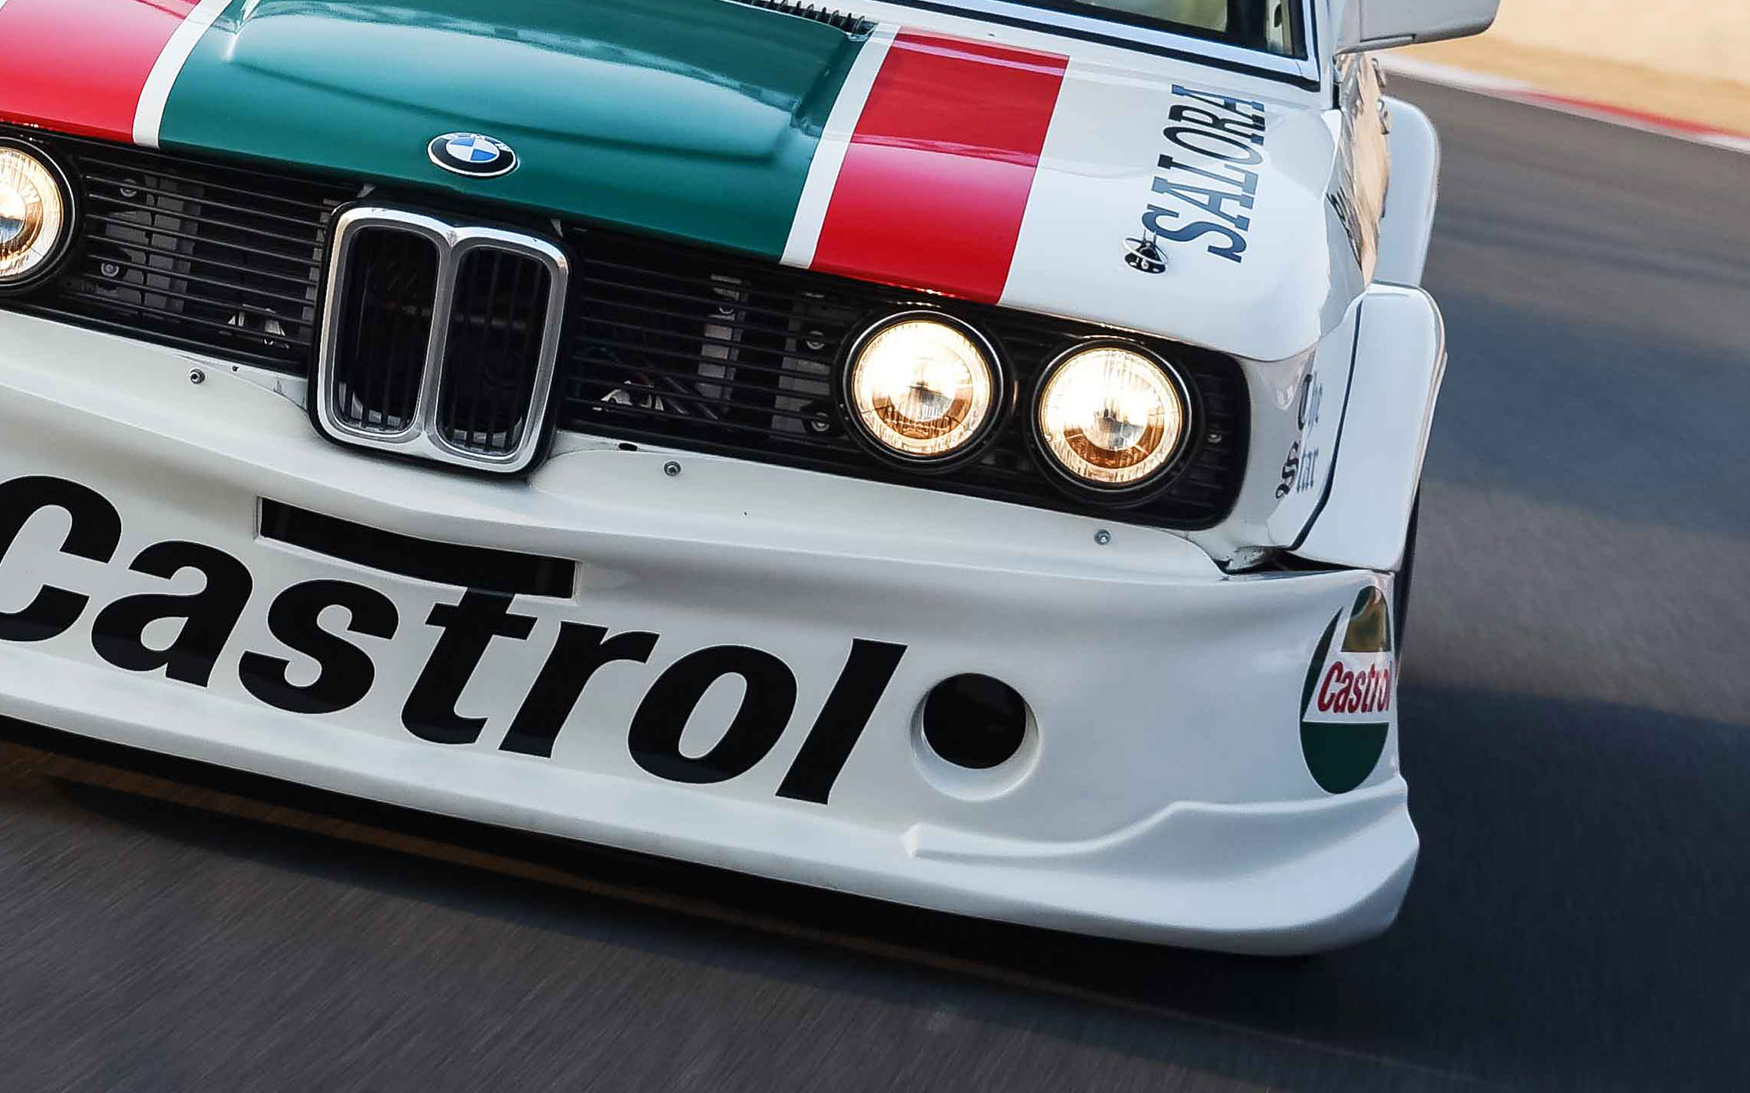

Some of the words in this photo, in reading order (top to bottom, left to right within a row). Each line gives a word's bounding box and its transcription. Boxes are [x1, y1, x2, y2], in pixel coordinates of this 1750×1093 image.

[1141, 83, 1267, 264] SALORA
[1275, 439, 1320, 500] Star
[1317, 660, 1393, 714] Castrol
